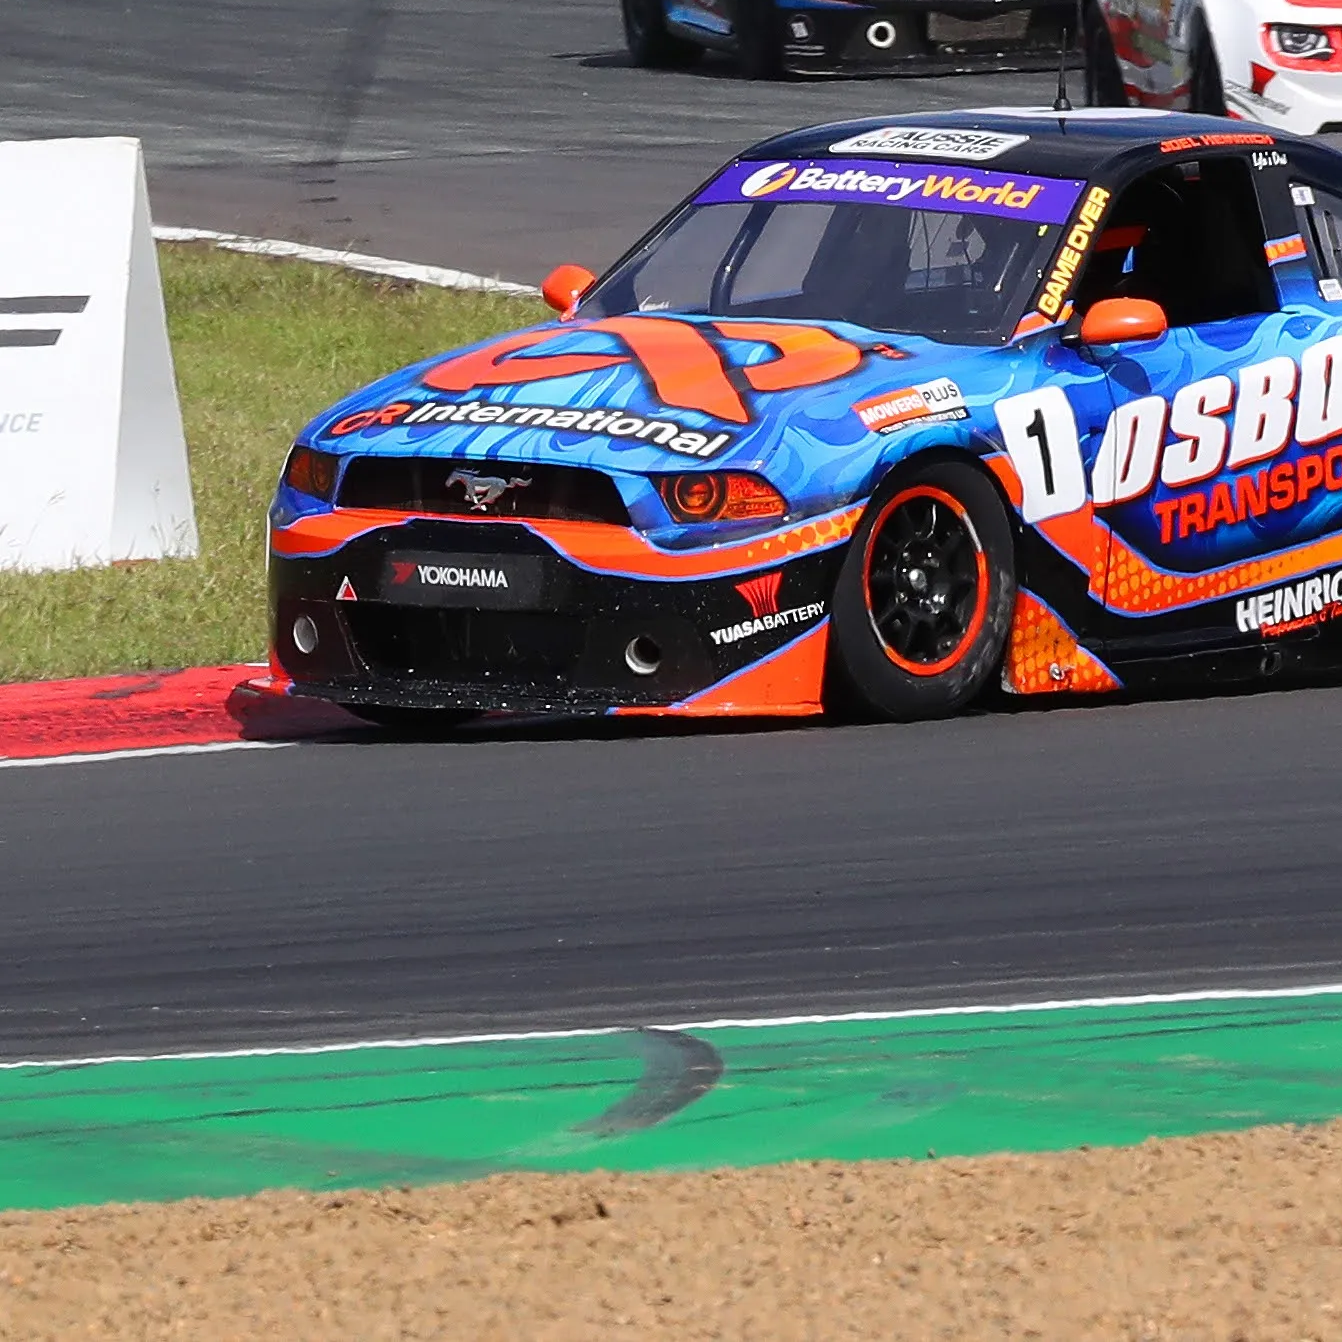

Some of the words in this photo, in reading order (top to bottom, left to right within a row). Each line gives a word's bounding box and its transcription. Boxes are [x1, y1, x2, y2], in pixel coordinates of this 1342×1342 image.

[852, 137, 931, 152] RACING
[932, 142, 993, 155] CARS
[895, 130, 1009, 148] AUSSIE
[1160, 135, 1200, 153] JOEL
[788, 167, 1042, 209] BatteryWorld
[1037, 185, 1112, 317] GAMEOVER
[859, 393, 924, 426] MOWERS
[922, 384, 959, 405] PLUS
[403, 402, 730, 458] International
[1026, 407, 1056, 496] 1
[417, 565, 509, 588] YOKOHAMA
